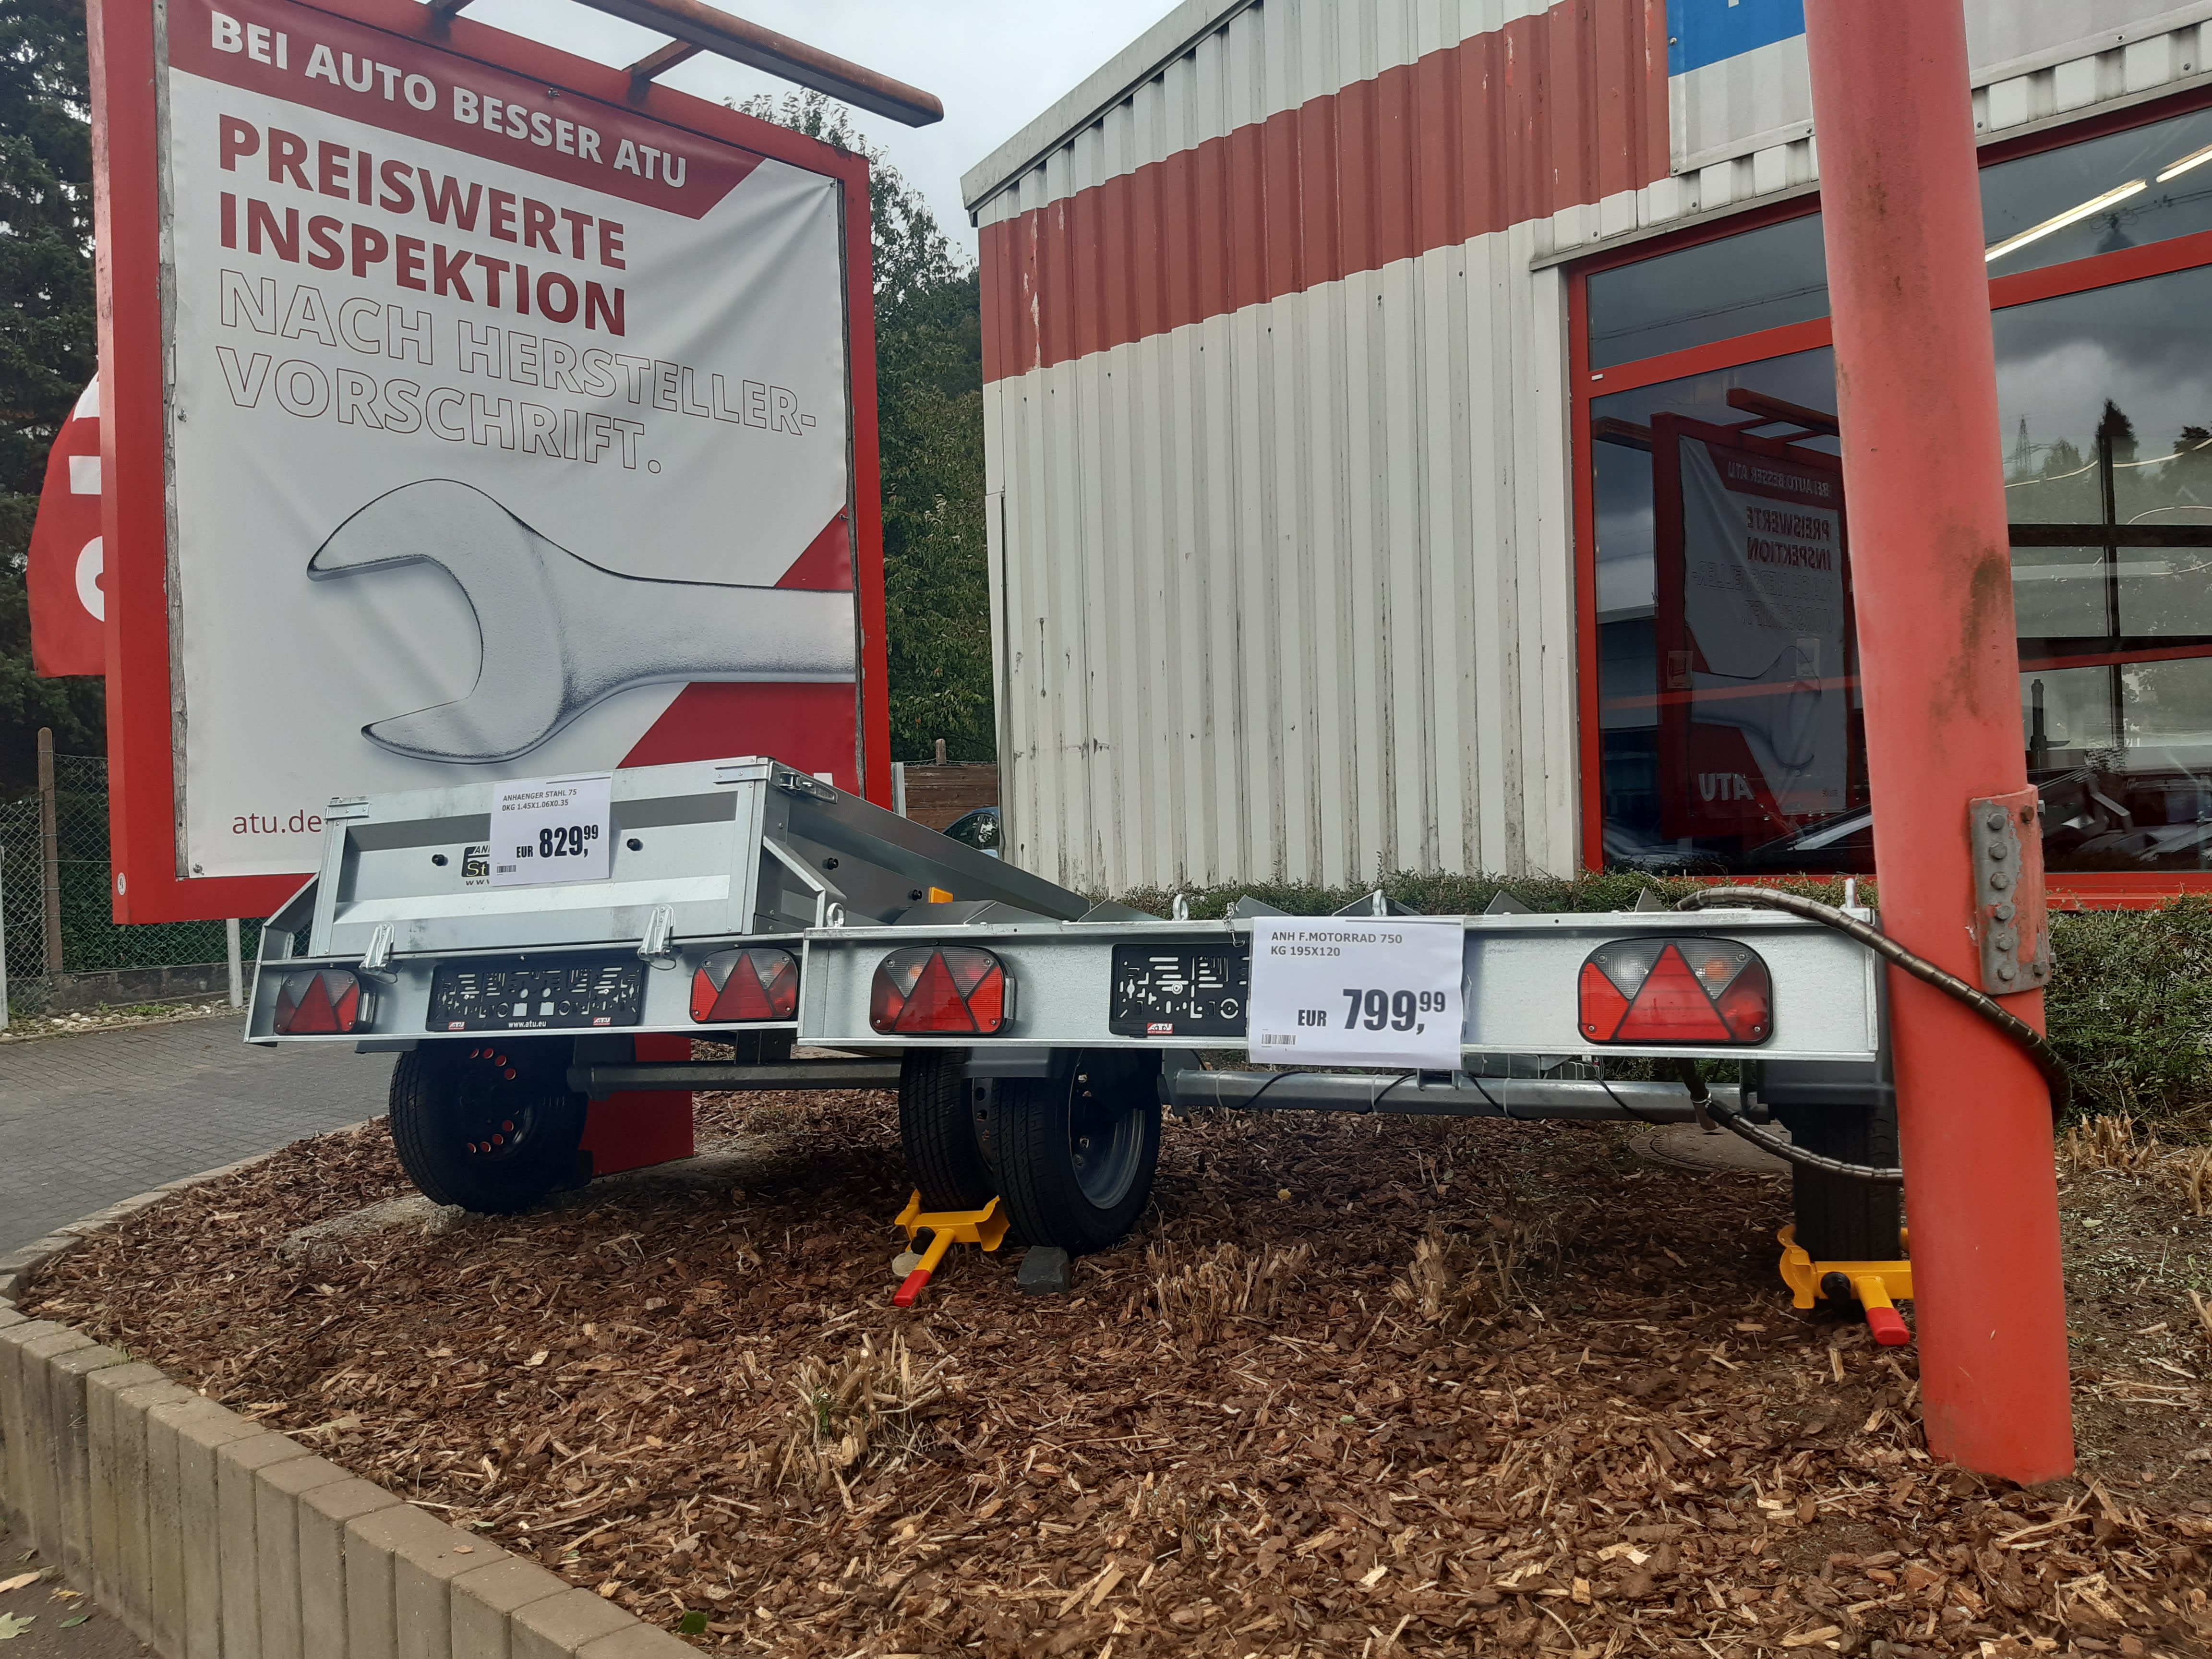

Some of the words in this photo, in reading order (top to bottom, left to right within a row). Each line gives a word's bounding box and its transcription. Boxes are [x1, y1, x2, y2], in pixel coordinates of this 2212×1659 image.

[210, 10, 288, 71] BEI
[304, 43, 437, 112] AUTO
[453, 86, 601, 164] BESSER
[613, 138, 687, 189] ATU
[219, 113, 627, 271] PREISWERTE
[219, 192, 626, 337] INSPEKTION
[220, 269, 433, 366] NACH
[458, 319, 817, 436] HERSTELLER-
[216, 345, 661, 474] VORSCHRIFT.
[503, 792, 543, 801] ANHAENGER
[545, 790, 566, 798] STAHL
[517, 799, 568, 810] 1.45X1.06X0.35
[232, 809, 322, 834] atu.de
[517, 846, 533, 858] EUR
[1271, 932, 1295, 941] ANH
[1298, 932, 1376, 943] F.MOTORRAD
[1380, 934, 1402, 944] 750
[1271, 946, 1286, 955] KG
[1290, 946, 1340, 956] 195X120
[1298, 1009, 1327, 1027] EUR
